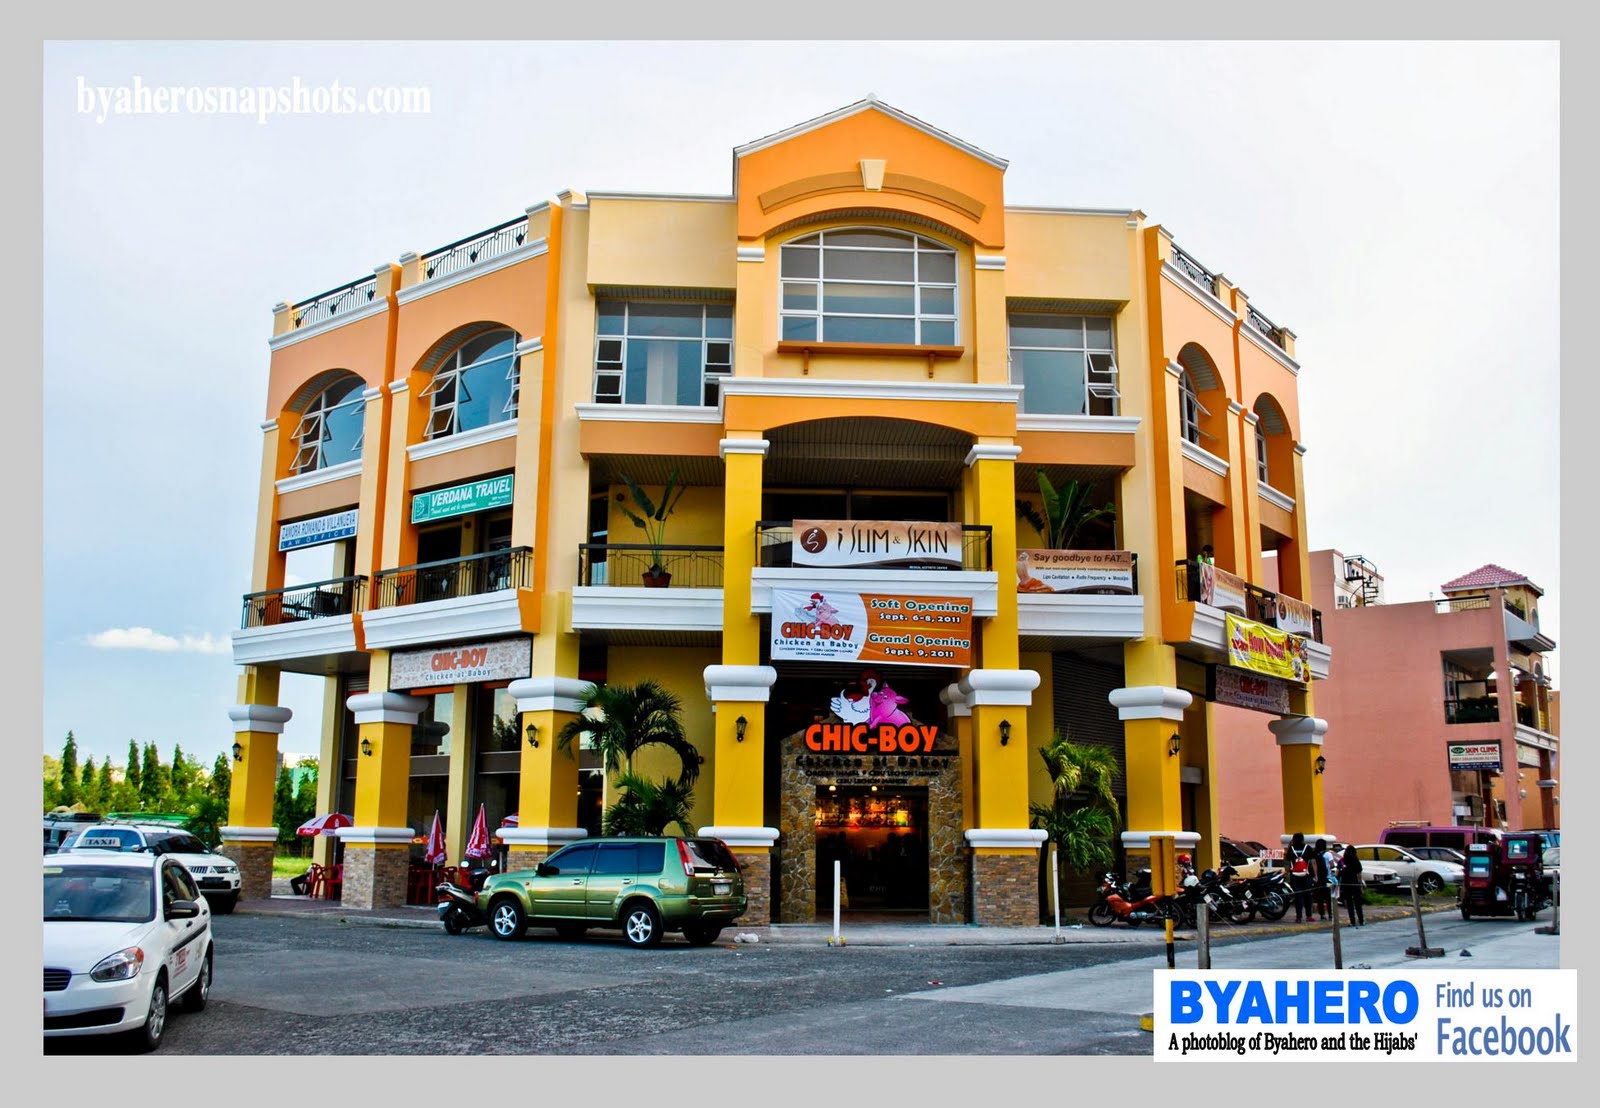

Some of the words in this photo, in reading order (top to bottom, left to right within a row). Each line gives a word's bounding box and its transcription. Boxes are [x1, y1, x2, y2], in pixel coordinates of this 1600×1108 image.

[431, 487, 473, 507] VERDANA
[475, 478, 511, 498] TRAVEL
[282, 539, 301, 548] LAW
[306, 527, 354, 542] OFFICES
[849, 523, 889, 556] SLIM
[892, 535, 902, 545] &
[906, 524, 948, 556] SKIN
[1033, 552, 1050, 563] Say
[1052, 553, 1091, 563] goodbye
[1093, 554, 1102, 562] to
[870, 598, 900, 610] Soft
[904, 600, 969, 614] Opening
[879, 612, 908, 621] Sept.
[937, 615, 961, 623] 2011
[781, 622, 854, 641] CHIC-BOY
[774, 638, 811, 646] Chicken
[815, 639, 826, 647] at
[830, 640, 859, 650] Baboy
[868, 632, 910, 644] Grand
[914, 635, 970, 649] Opening
[431, 647, 488, 672] CHIC-BOY
[884, 647, 914, 657] Sept.
[917, 648, 928, 658] 9,
[930, 650, 955, 658] 2011
[425, 673, 453, 681] Chicken
[468, 669, 491, 678] Baboy
[805, 724, 938, 753] CHIC-BOY
[796, 755, 864, 768] Chicken
